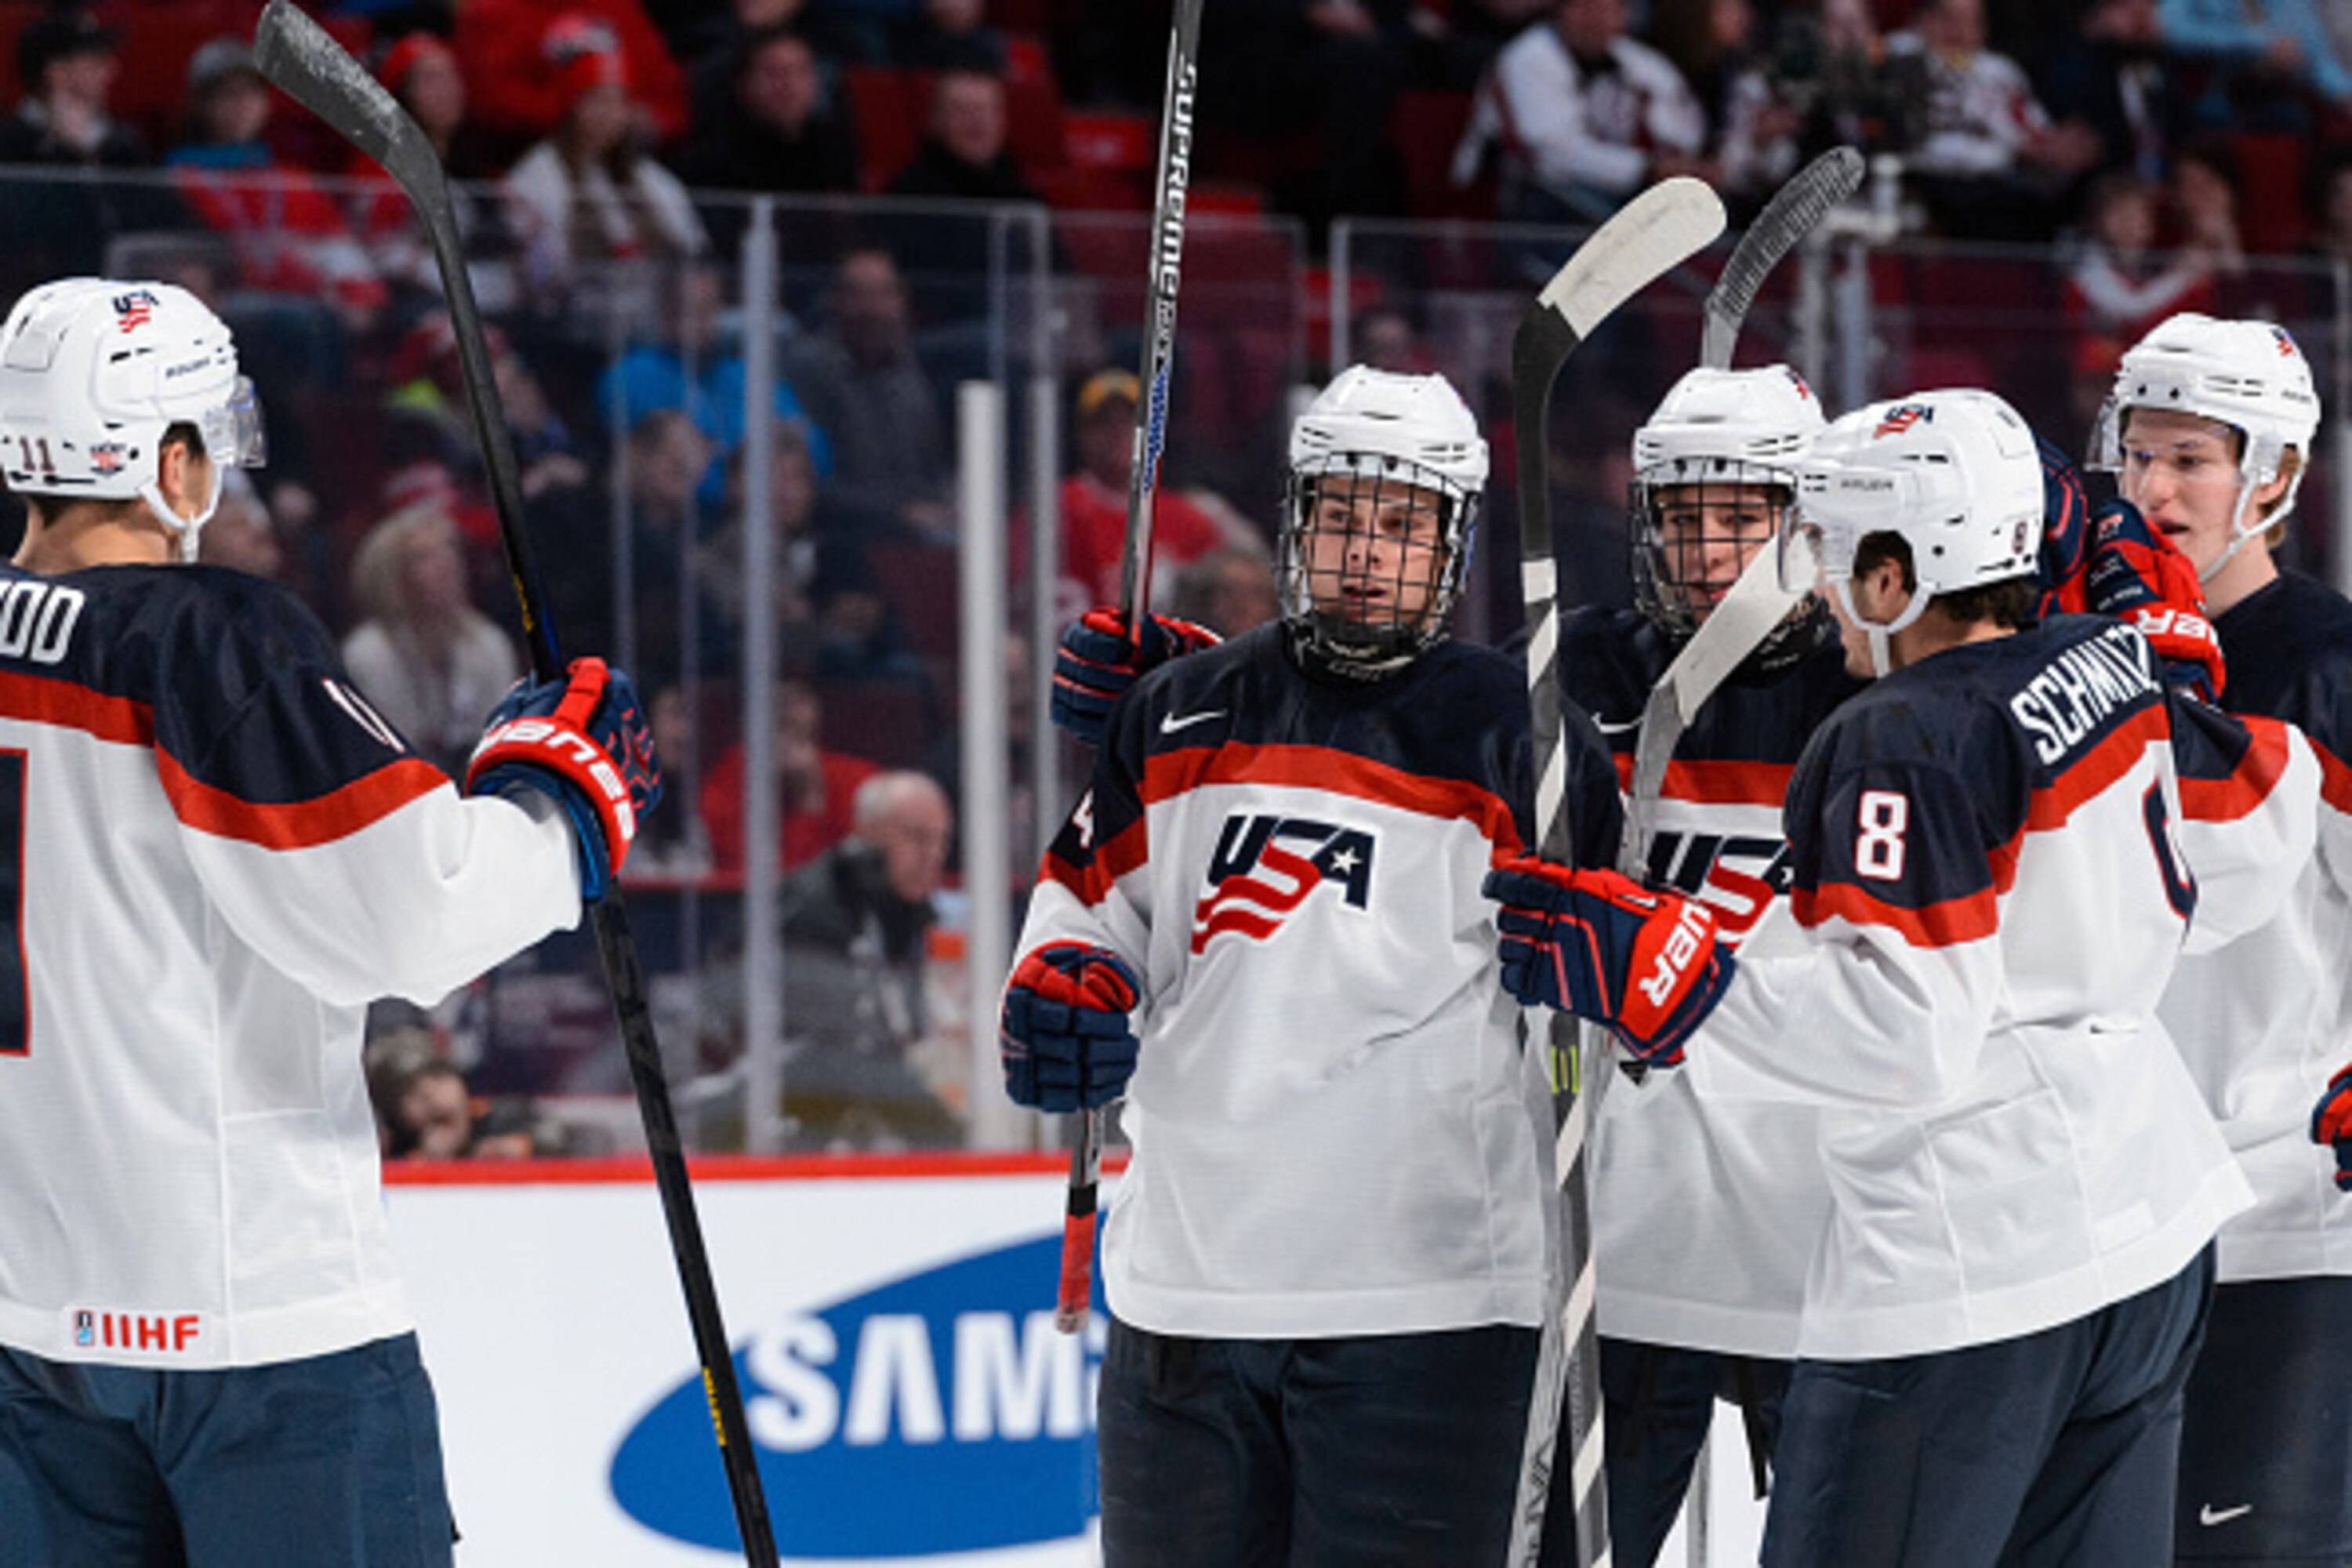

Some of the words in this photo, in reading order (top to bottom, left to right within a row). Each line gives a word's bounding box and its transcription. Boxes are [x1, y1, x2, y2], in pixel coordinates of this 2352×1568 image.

[1854, 789, 1908, 882] 8
[1190, 814, 1377, 956] USA
[103, 1312, 199, 1351] IIHF
